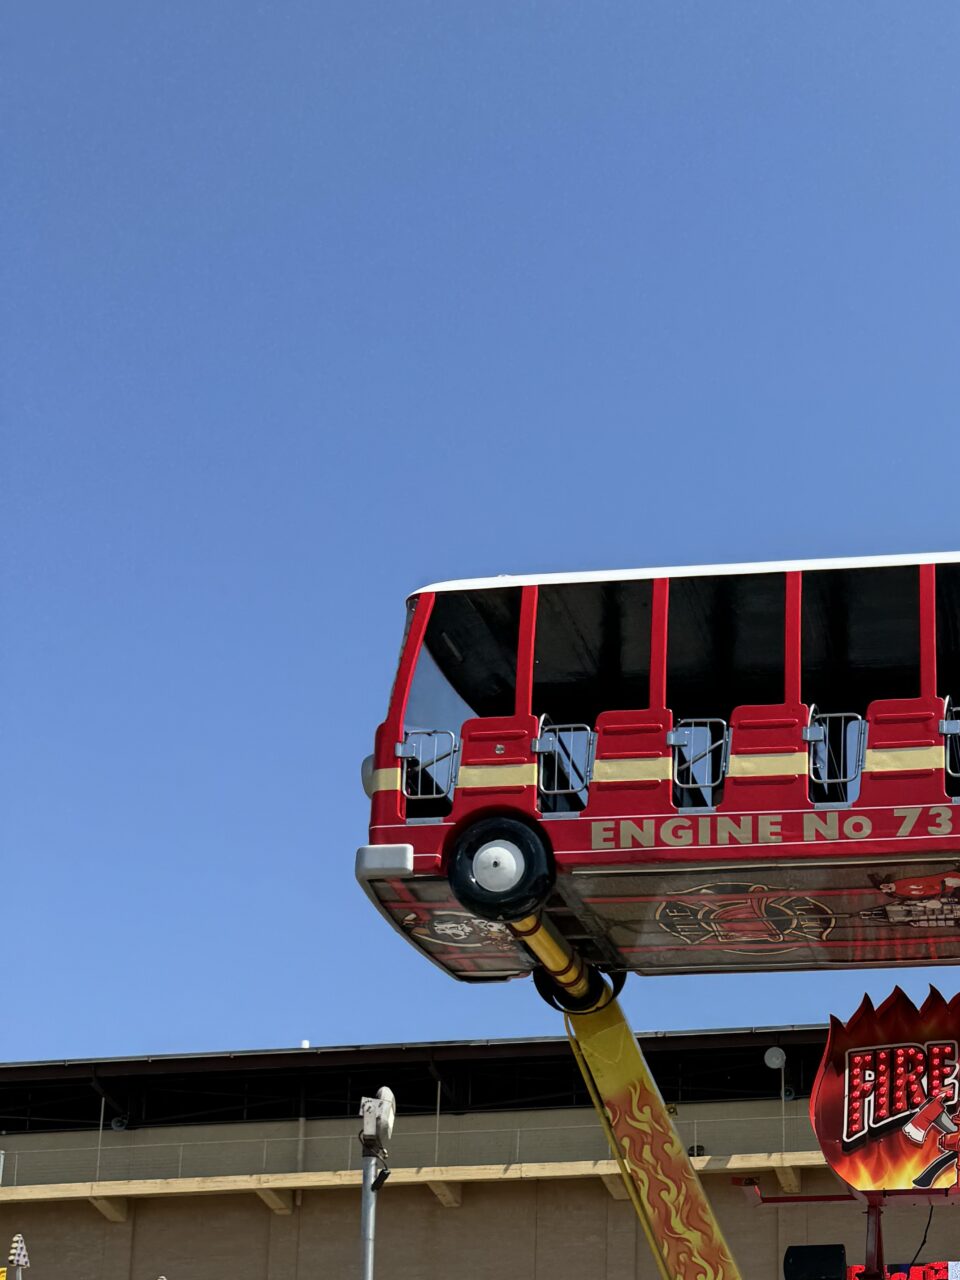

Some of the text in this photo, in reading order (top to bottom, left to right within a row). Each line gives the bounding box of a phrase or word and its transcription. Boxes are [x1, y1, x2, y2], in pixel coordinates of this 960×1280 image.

[591, 806, 954, 850] ENGINE No 73
[845, 1041, 958, 1139] FIRE
